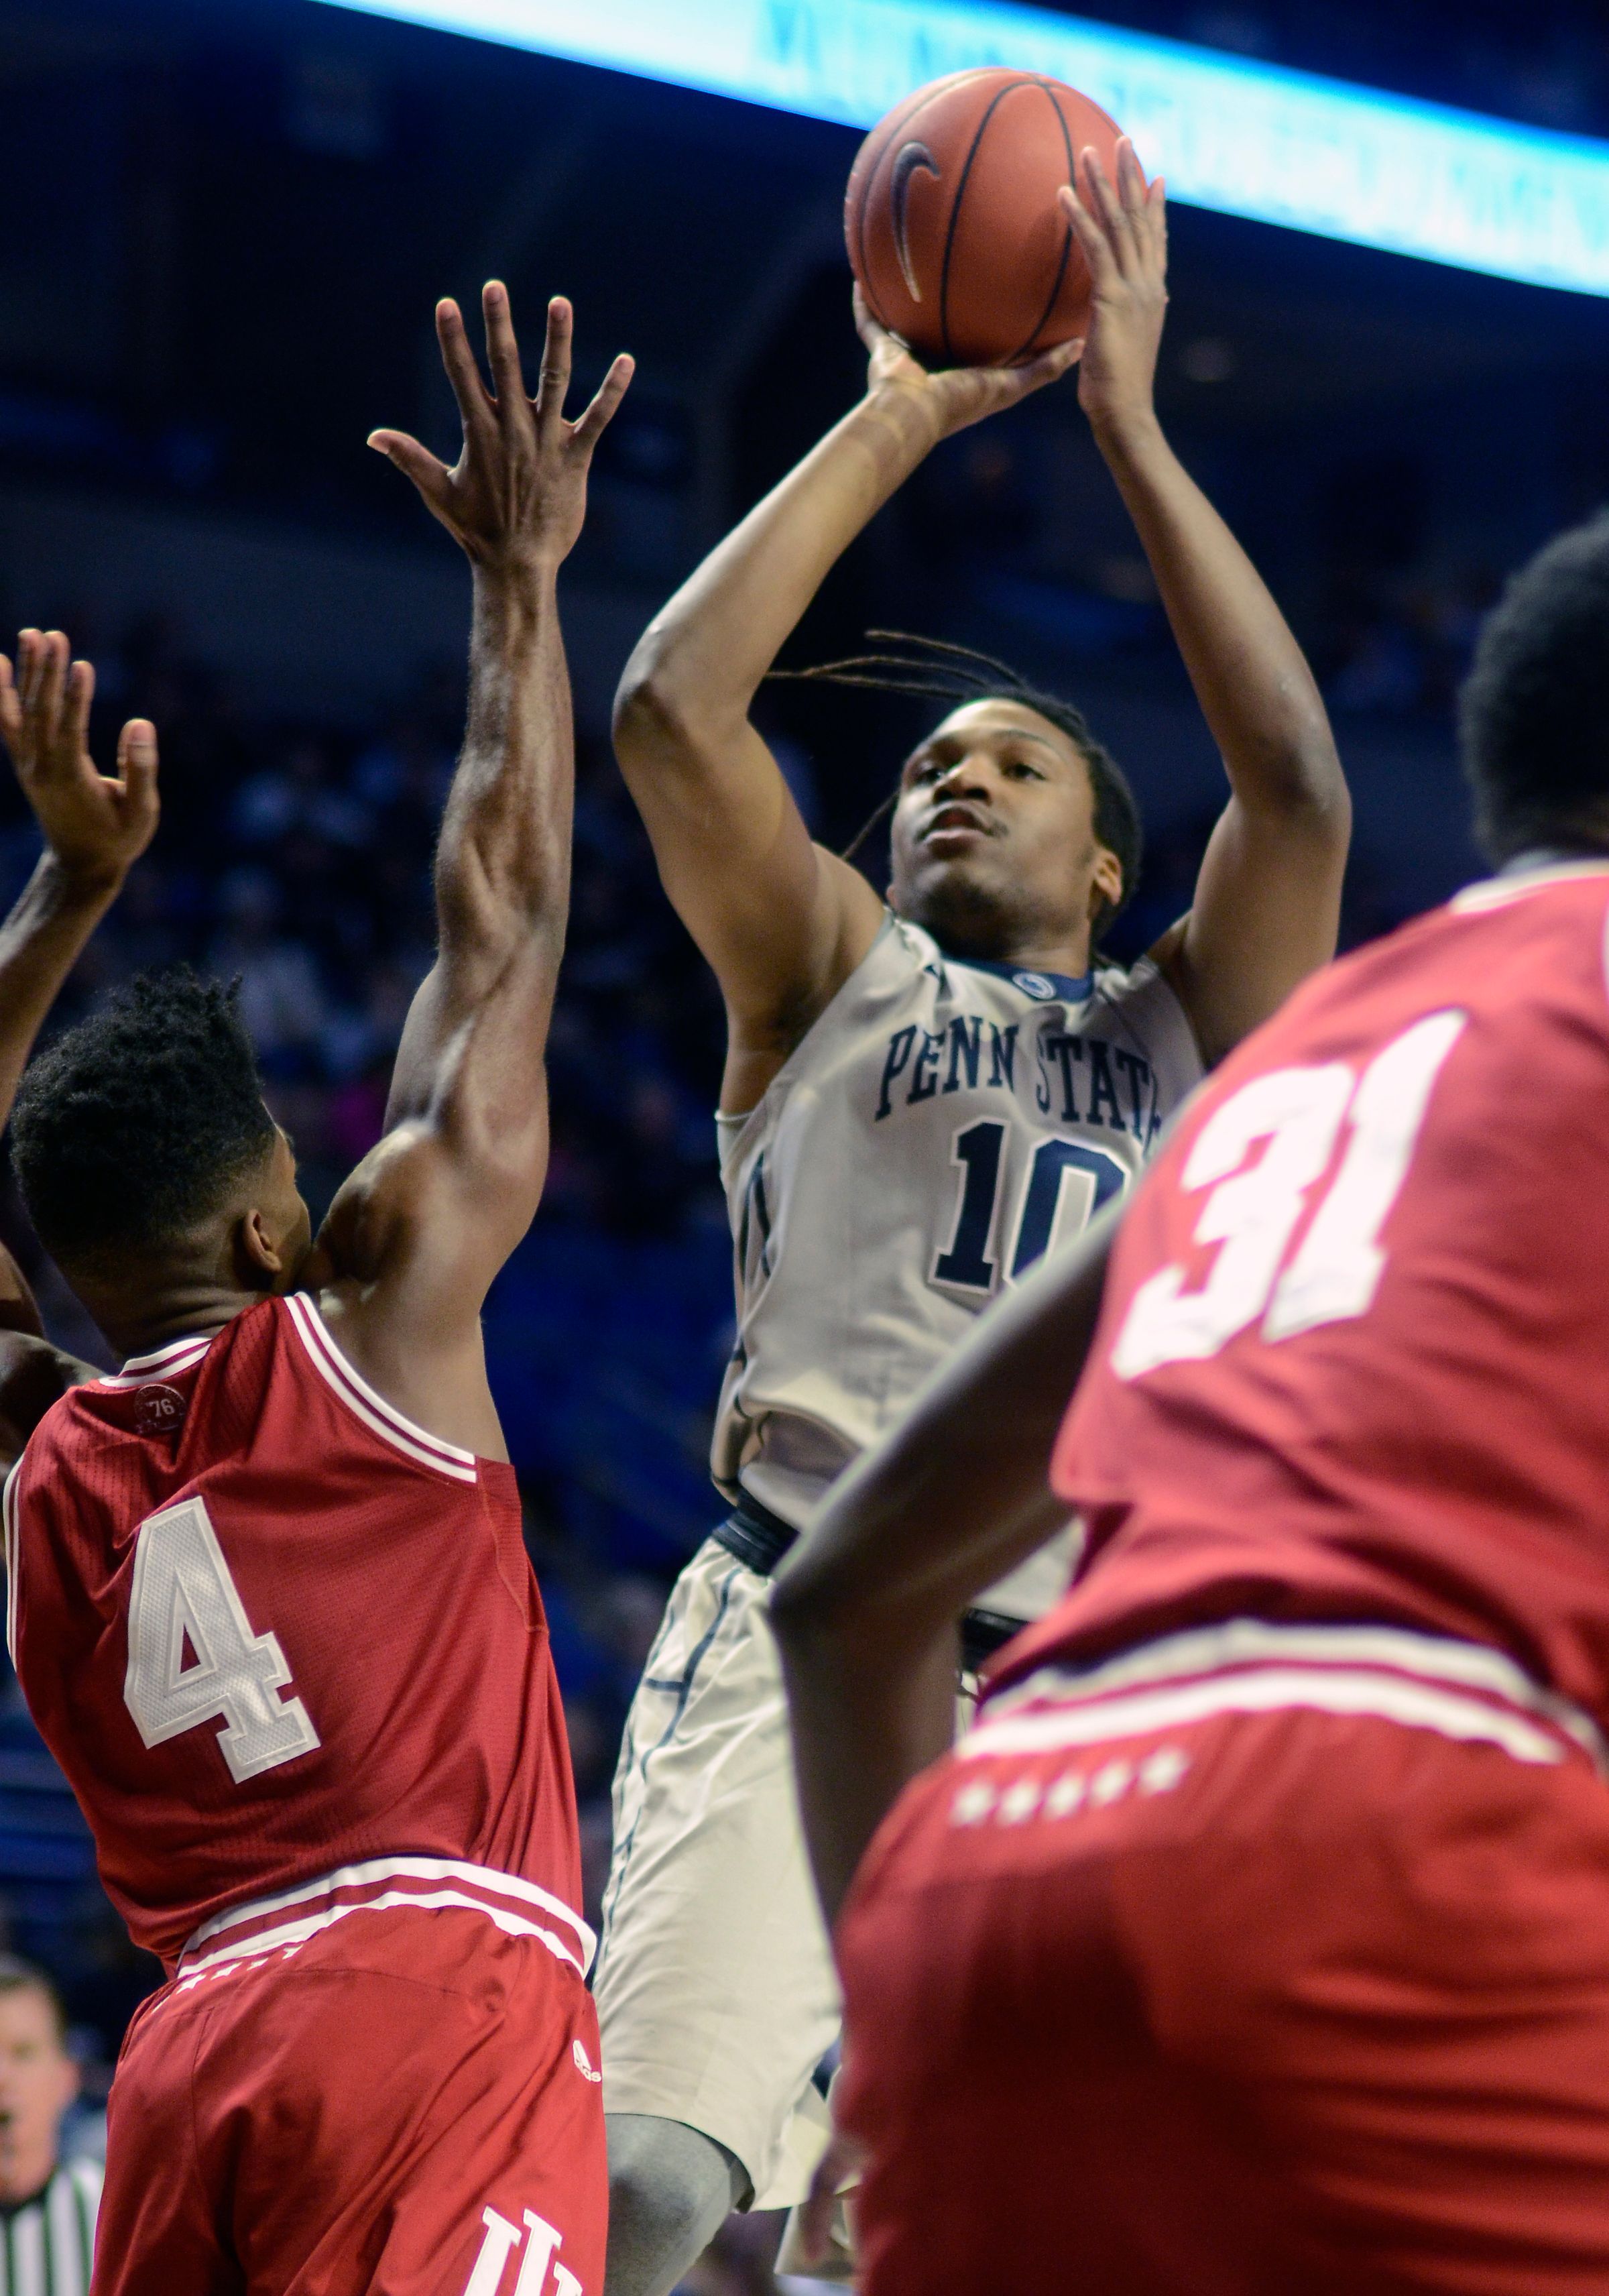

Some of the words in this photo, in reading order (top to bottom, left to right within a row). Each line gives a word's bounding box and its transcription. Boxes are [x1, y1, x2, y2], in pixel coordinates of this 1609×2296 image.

[876, 1015, 1018, 1121] PENN
[929, 1115, 1132, 1294] 10
[1110, 1008, 1466, 1381] 31
[145, 1398, 175, 1418] 76
[123, 1495, 321, 1784] 4
